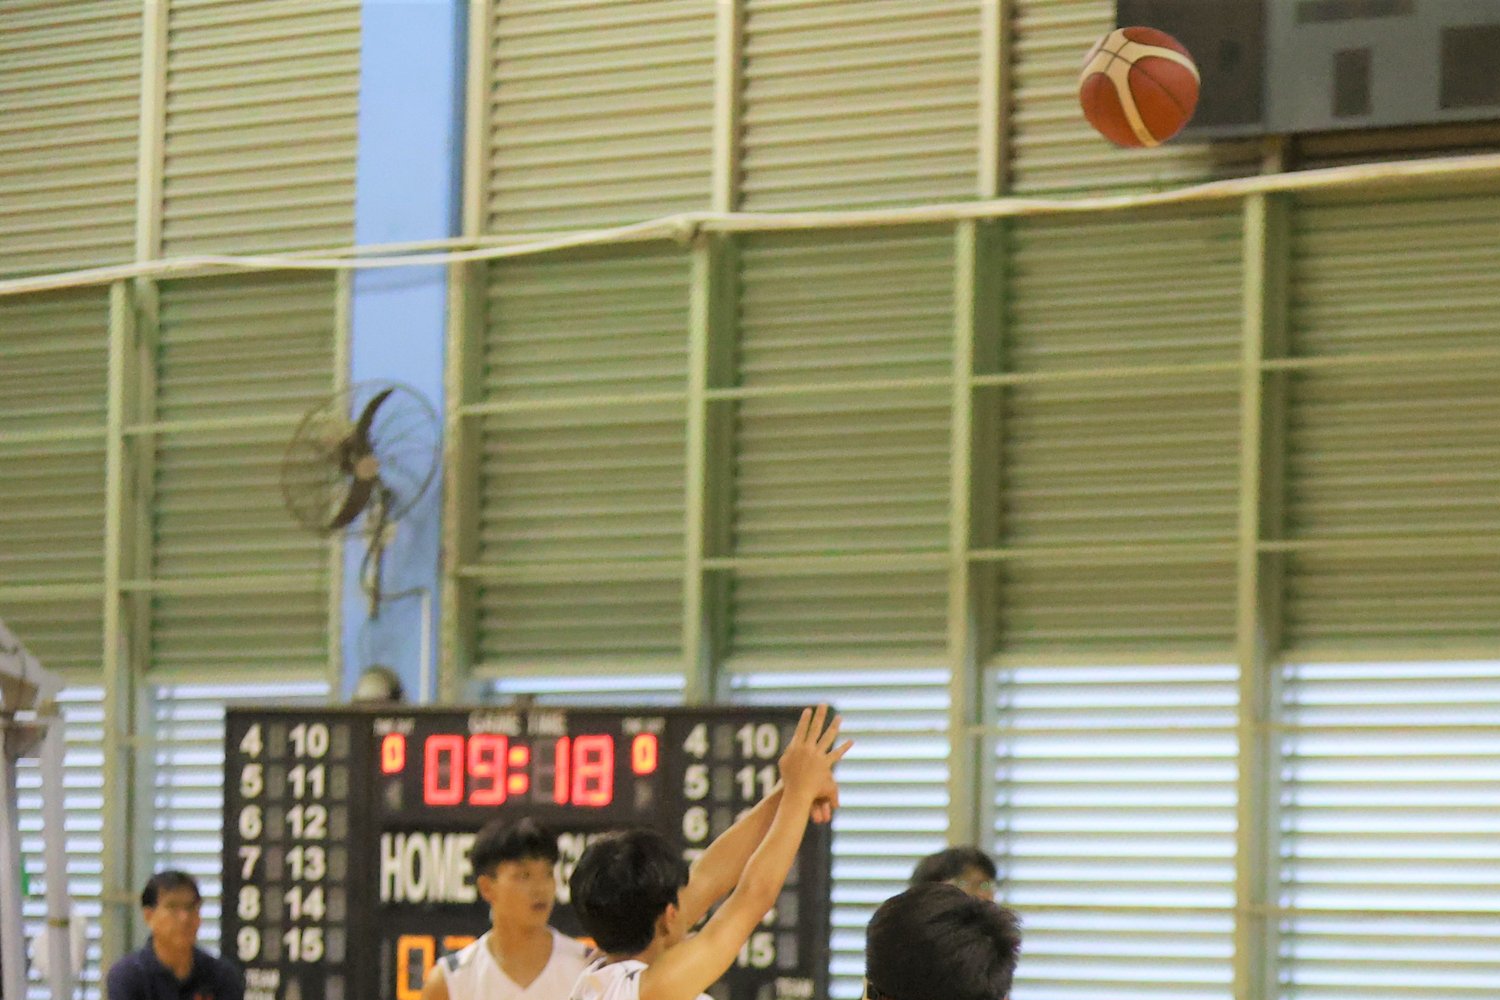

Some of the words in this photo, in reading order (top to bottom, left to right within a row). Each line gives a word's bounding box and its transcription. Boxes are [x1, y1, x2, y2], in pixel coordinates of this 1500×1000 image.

[239, 722, 263, 759] 4
[288, 722, 329, 759] 10
[381, 732, 406, 775] 0
[631, 732, 658, 775] 0
[683, 722, 709, 759] 4
[735, 722, 779, 759] 10
[240, 763, 263, 799] 5
[287, 763, 325, 799] 11
[424, 734, 614, 806] 09:18
[683, 764, 709, 800] 5
[735, 764, 776, 800] 11
[238, 804, 262, 840] 6
[286, 804, 327, 840] 12
[682, 806, 708, 843] 6
[238, 844, 262, 880] 7
[286, 844, 326, 881] 13
[379, 832, 478, 904] HOME
[237, 885, 261, 921] 8
[284, 885, 326, 922] 14
[237, 926, 261, 962] 9
[283, 926, 324, 962] 15
